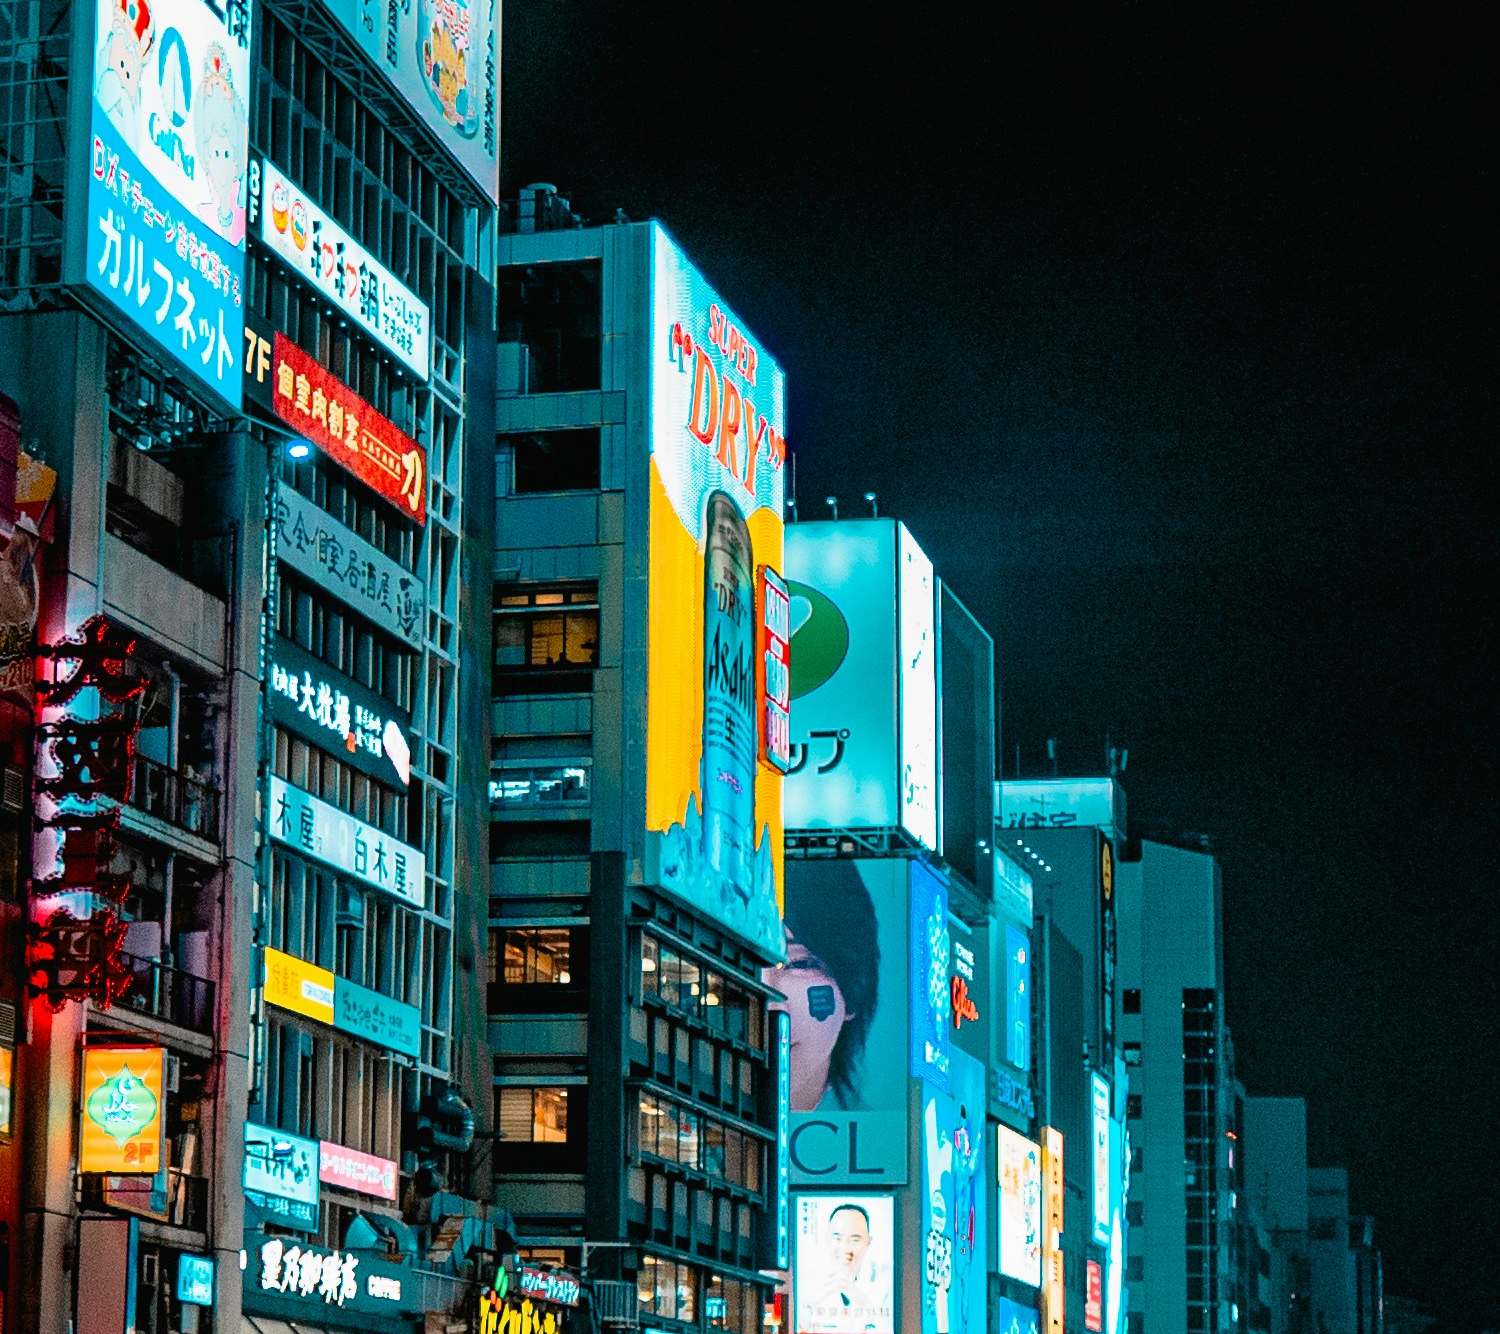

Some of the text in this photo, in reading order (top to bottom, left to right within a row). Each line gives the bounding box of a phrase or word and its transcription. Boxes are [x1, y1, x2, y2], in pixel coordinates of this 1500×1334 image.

[98, 208, 234, 381] ガルフネット
[244, 327, 272, 384] 7F
[708, 303, 759, 387] SUPER
[278, 358, 360, 455] 個室肉割烹
[401, 449, 424, 512] 刀
[708, 619, 753, 717] Asahi
[297, 669, 351, 743] 大牧場
[123, 1142, 154, 1164] 2F
[261, 1238, 359, 1305] 星乃珈琲店
